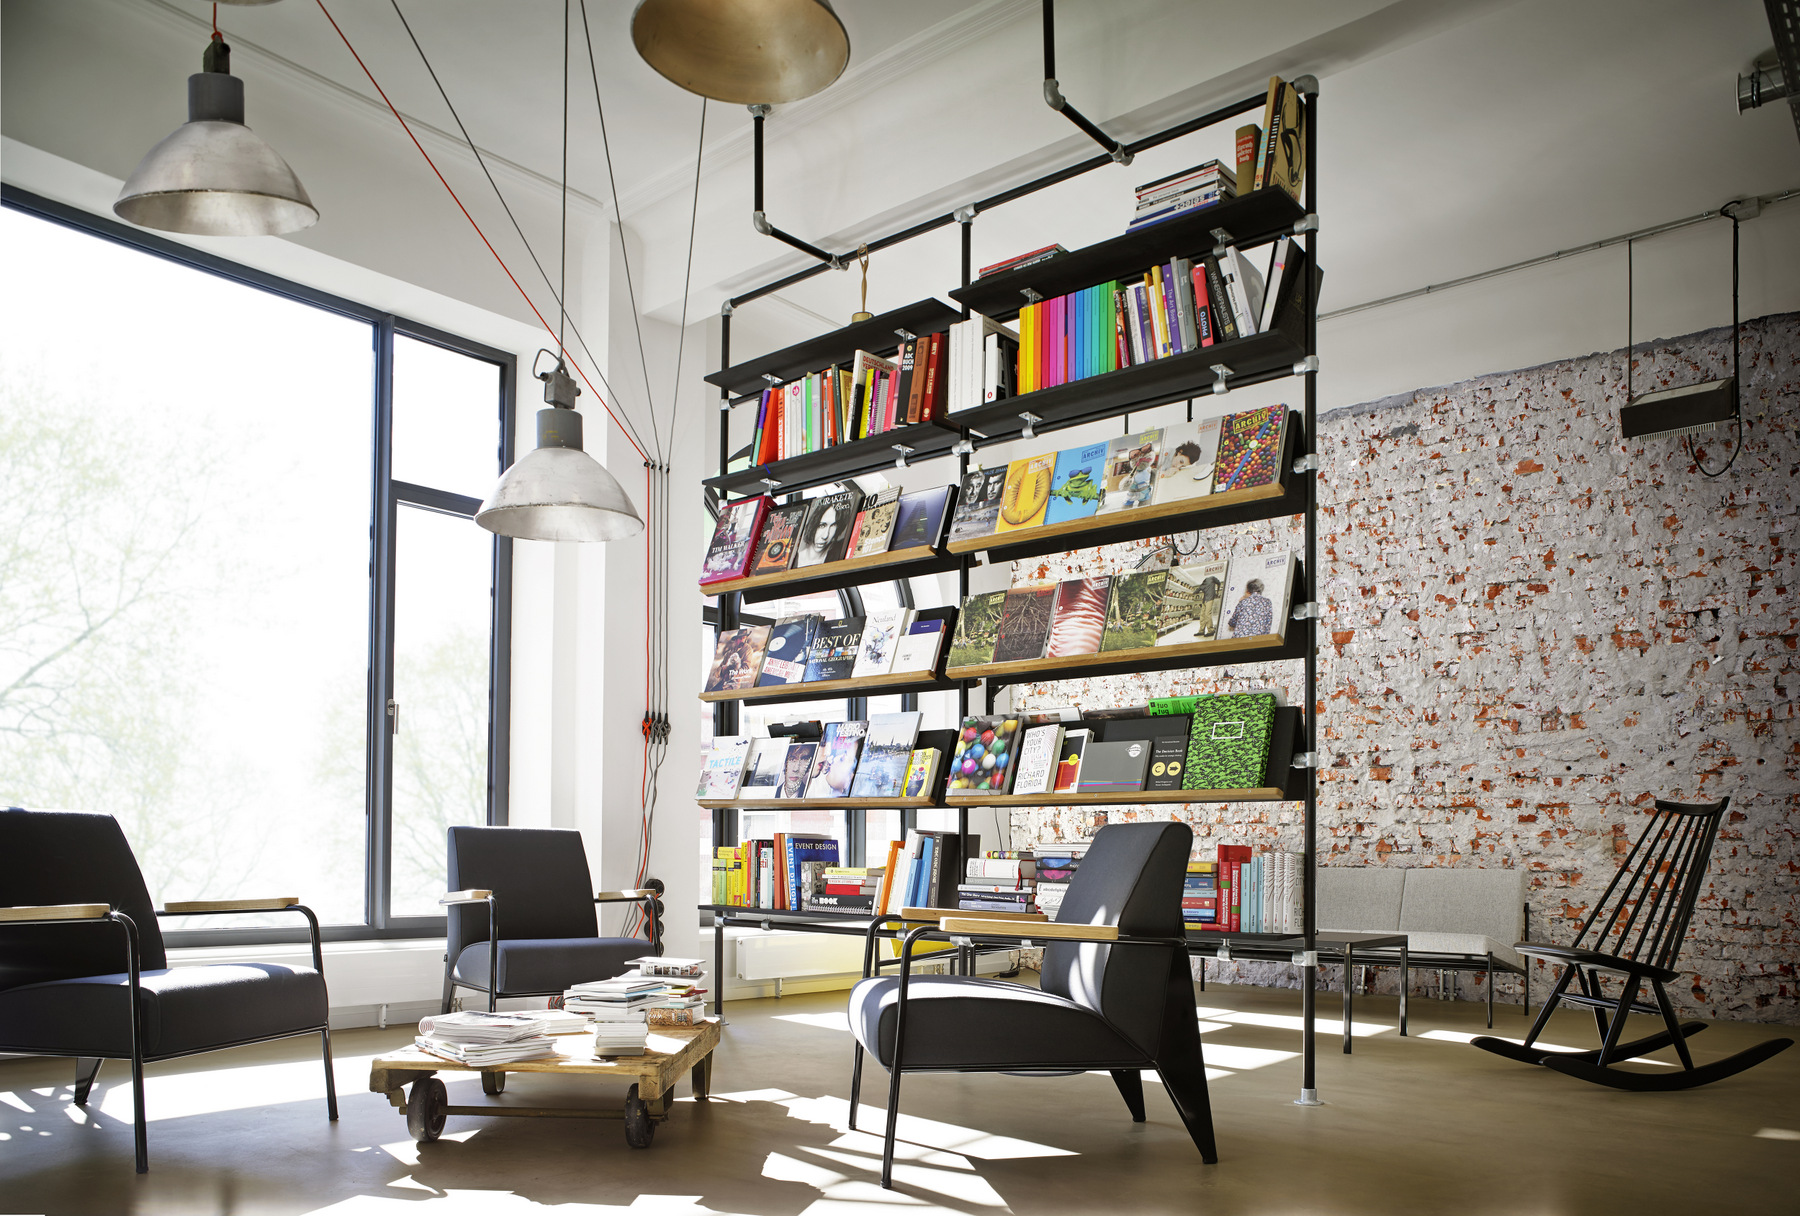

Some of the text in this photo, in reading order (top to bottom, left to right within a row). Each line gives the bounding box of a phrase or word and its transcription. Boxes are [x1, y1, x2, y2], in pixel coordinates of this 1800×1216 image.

[1200, 311, 1208, 336] PHOTO
[862, 356, 894, 370] DEUTSCHLAND
[1235, 411, 1268, 430] ARCHIV
[1082, 448, 1104, 460] ARCHIV
[1030, 458, 1052, 470] ARCHIV
[864, 493, 878, 507] 10
[1266, 558, 1285, 566] ARCHIV
[812, 634, 861, 650] BEST OF
[1026, 729, 1045, 739] WHO'S
[1026, 738, 1042, 746] YOUR
[1024, 746, 1041, 755] CITY?
[709, 756, 742, 768] TACTILE
[1018, 770, 1045, 780] RICHARD
[1016, 780, 1042, 788] FLORIDA
